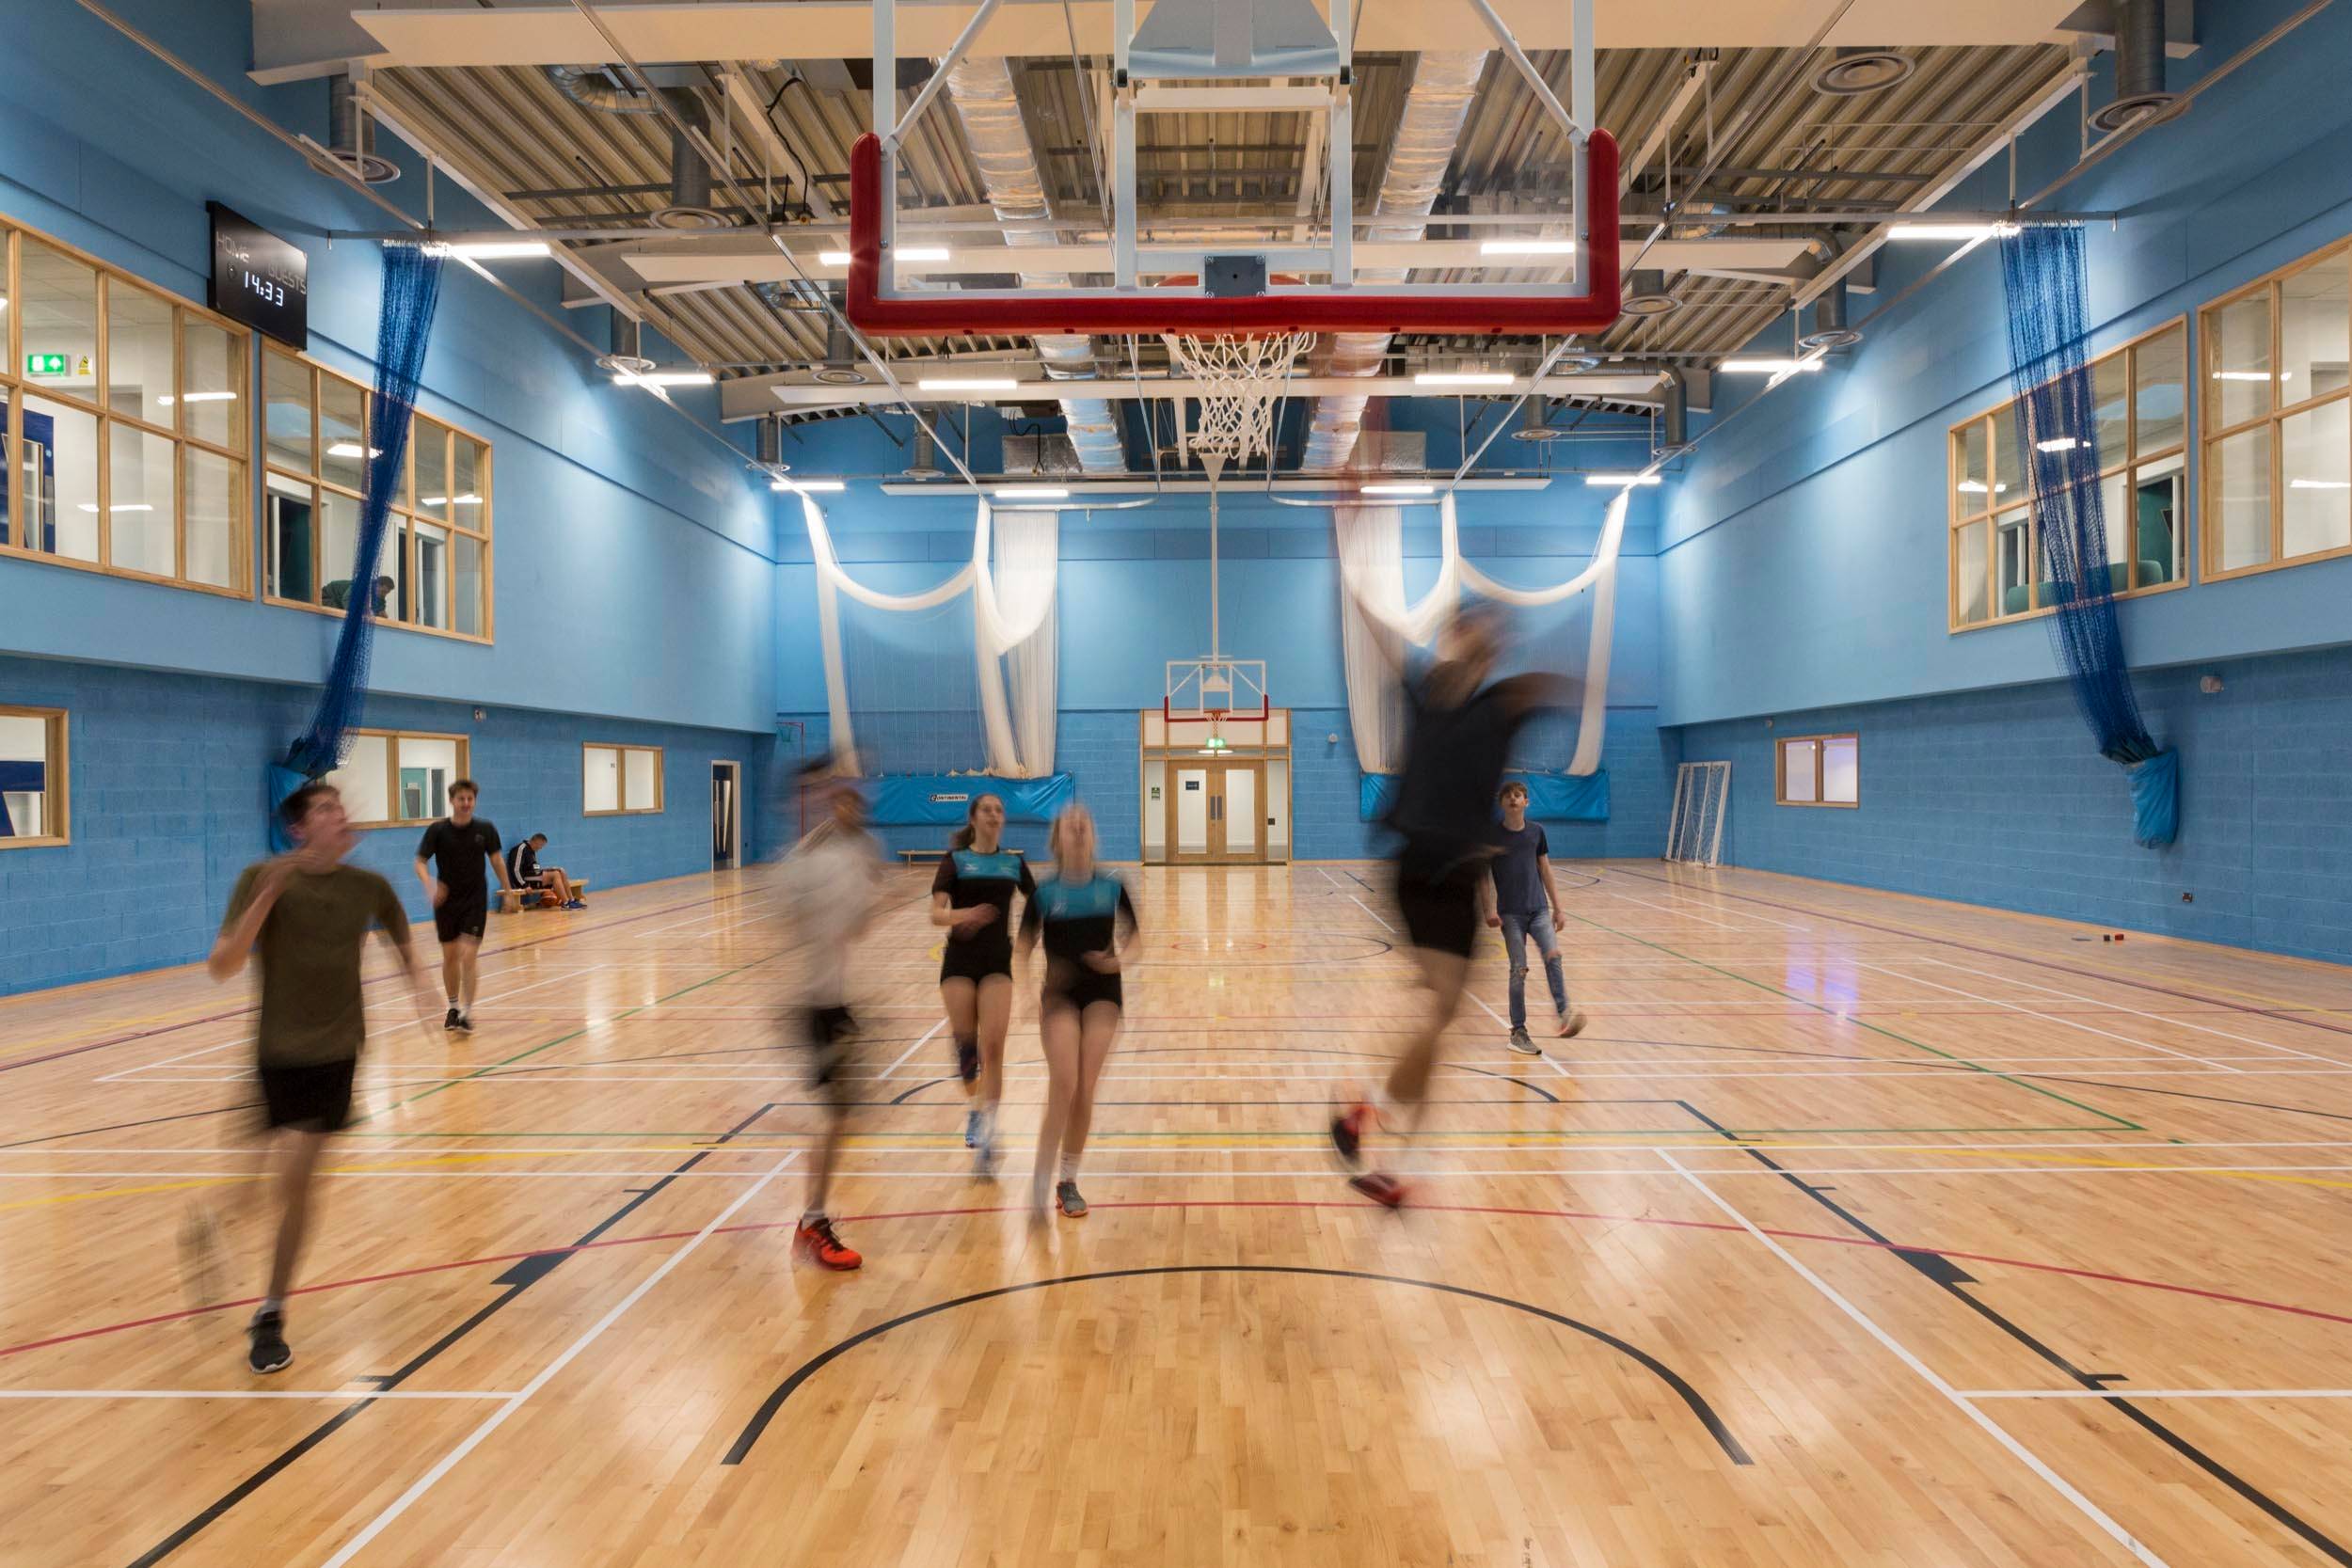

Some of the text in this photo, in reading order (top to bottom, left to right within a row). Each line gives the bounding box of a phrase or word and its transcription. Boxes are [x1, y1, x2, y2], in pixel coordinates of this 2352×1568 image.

[216, 230, 250, 262] HOME
[245, 270, 284, 307] 14:33
[268, 264, 307, 294] GUESTS
